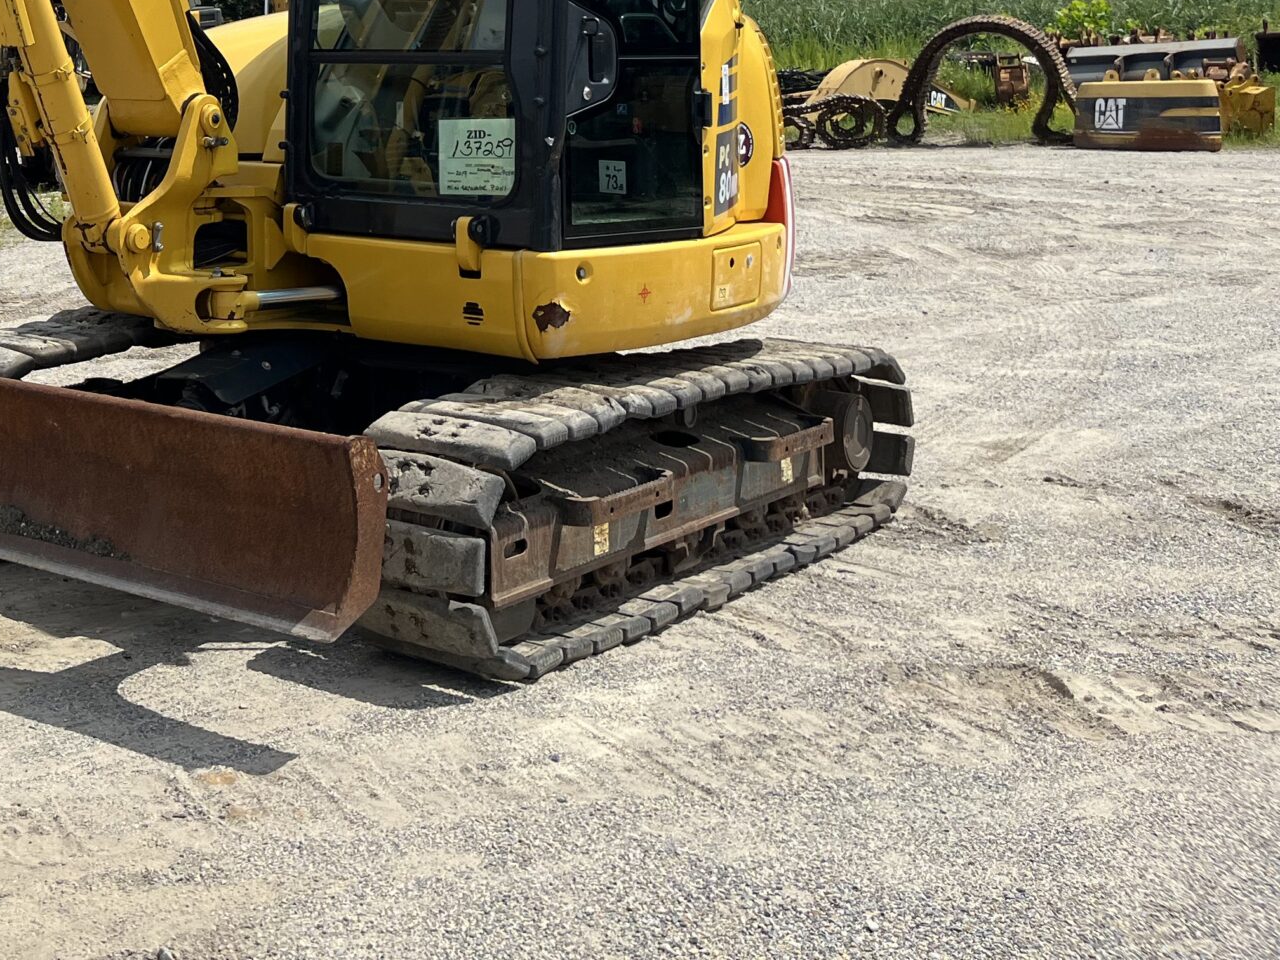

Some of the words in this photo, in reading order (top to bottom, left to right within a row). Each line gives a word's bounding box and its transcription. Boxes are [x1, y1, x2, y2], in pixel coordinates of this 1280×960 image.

[931, 90, 947, 107] CAT
[1094, 98, 1126, 129] CAT
[466, 130, 492, 139] ZID-
[452, 137, 514, 158] 137259
[719, 144, 730, 169] PC
[605, 174, 619, 190] 73
